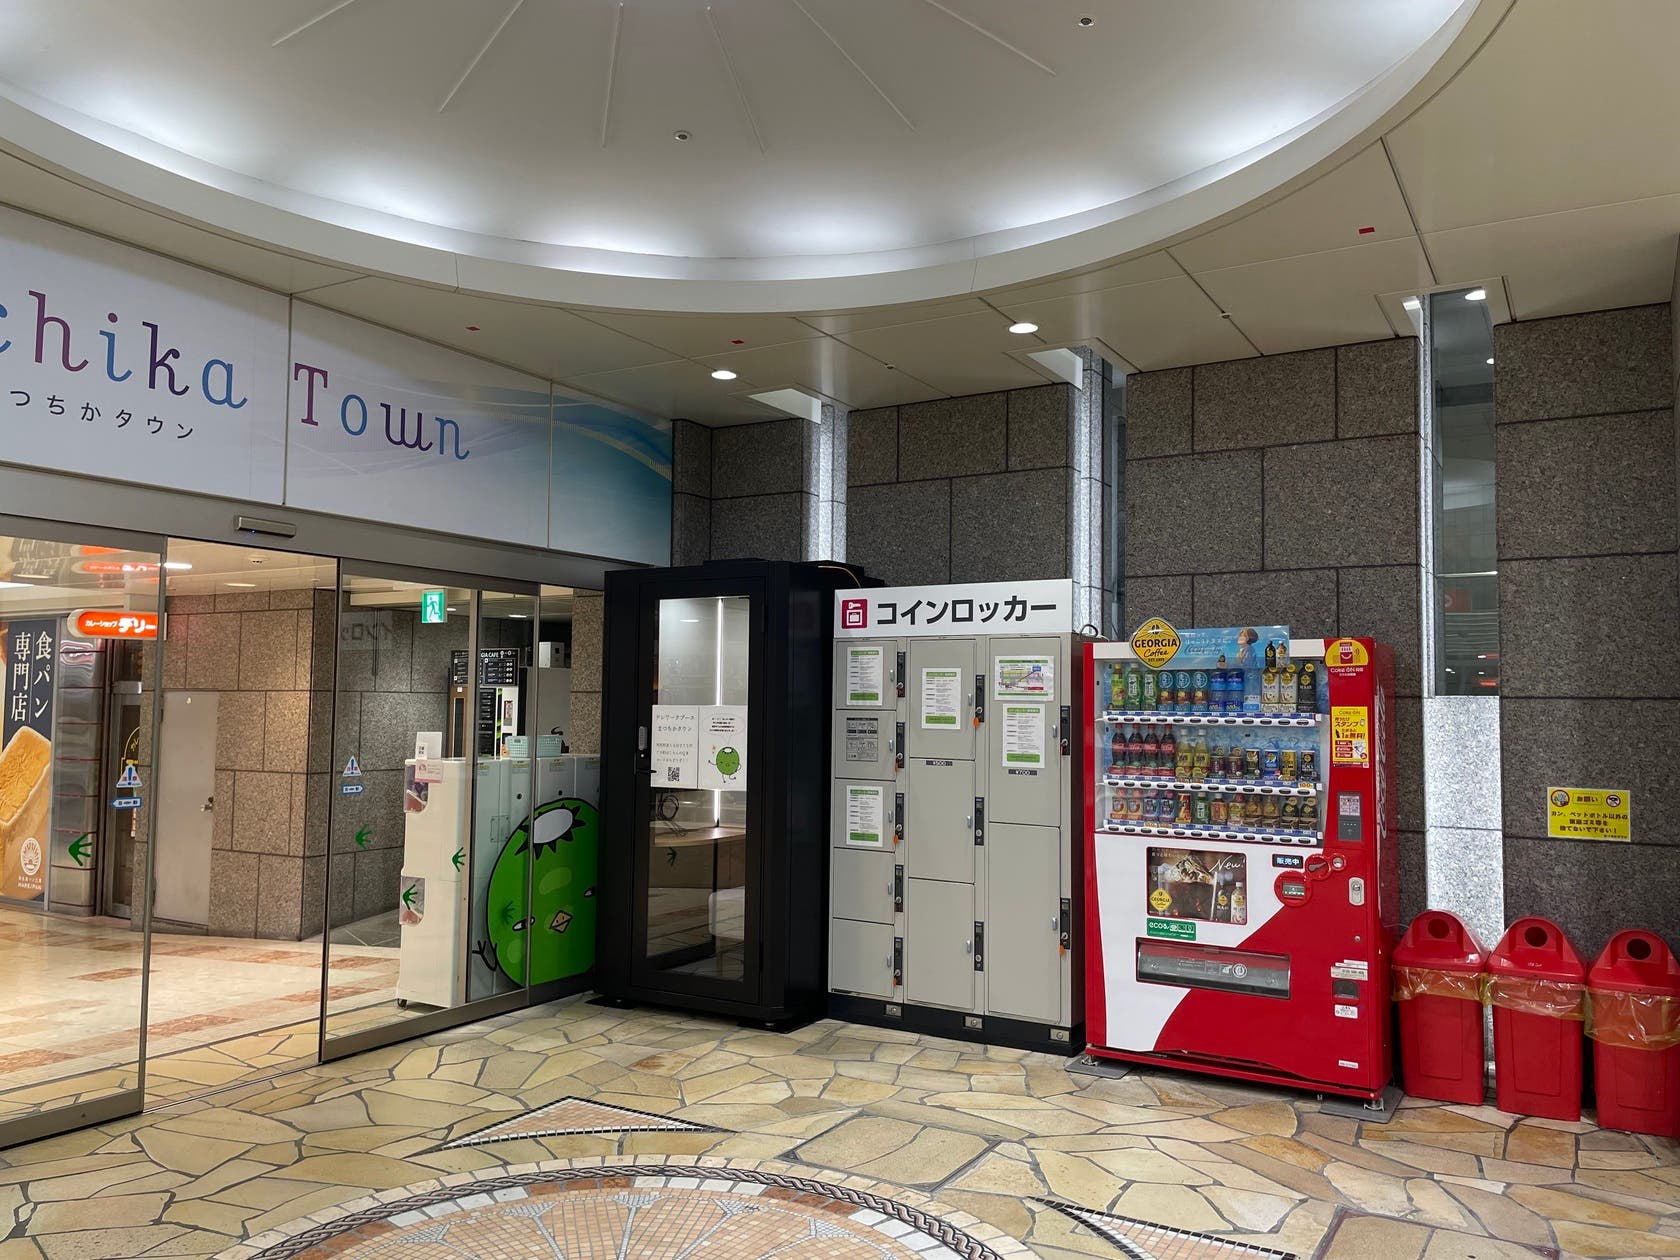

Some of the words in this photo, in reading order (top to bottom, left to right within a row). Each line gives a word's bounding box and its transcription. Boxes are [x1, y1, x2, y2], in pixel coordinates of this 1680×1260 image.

[293, 362, 471, 461] Town
[877, 595, 1057, 626] コインロッカー
[118, 616, 157, 634] デリー
[1134, 638, 1179, 649] GEORGIA
[1143, 647, 1169, 659] Coffee
[11, 631, 31, 722] 専門店
[33, 631, 53, 719] 食パン
[1276, 857, 1300, 866] 販売中
